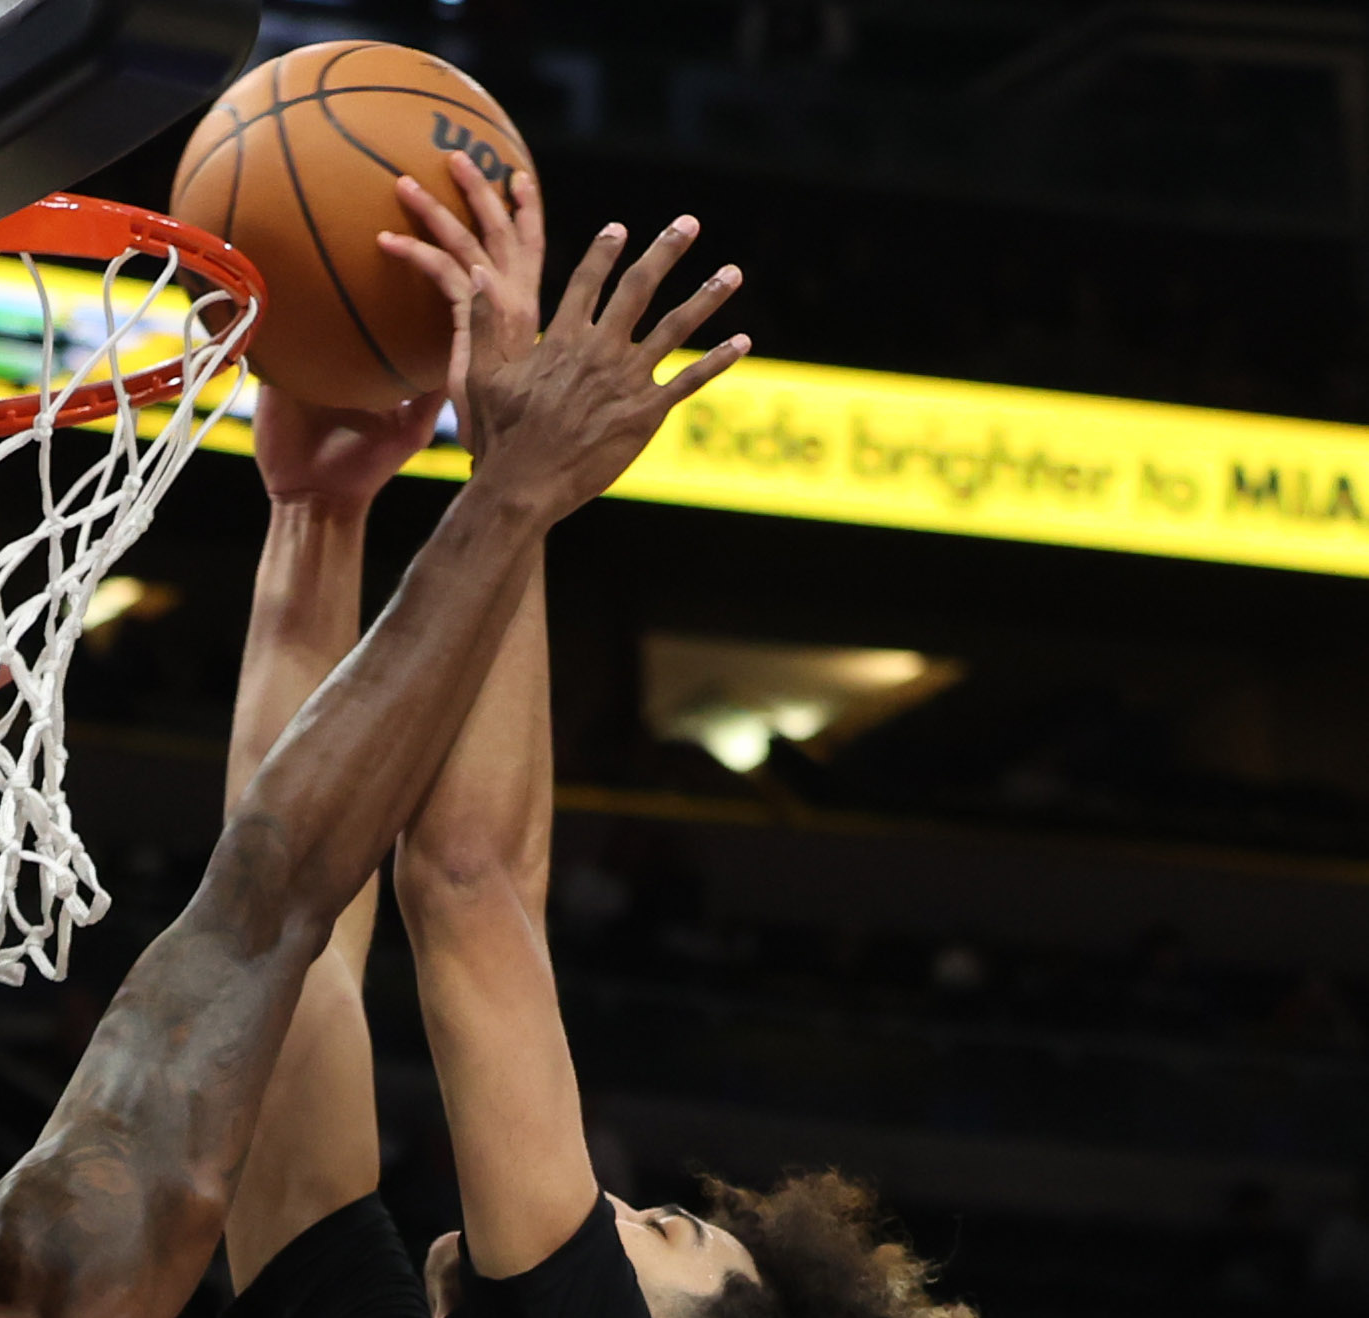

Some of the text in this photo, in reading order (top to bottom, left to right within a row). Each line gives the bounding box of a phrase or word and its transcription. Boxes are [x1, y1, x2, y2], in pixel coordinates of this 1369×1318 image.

[683, 400, 822, 468] Ride
[852, 412, 1114, 506] brighter
[1140, 462, 1201, 514] to
